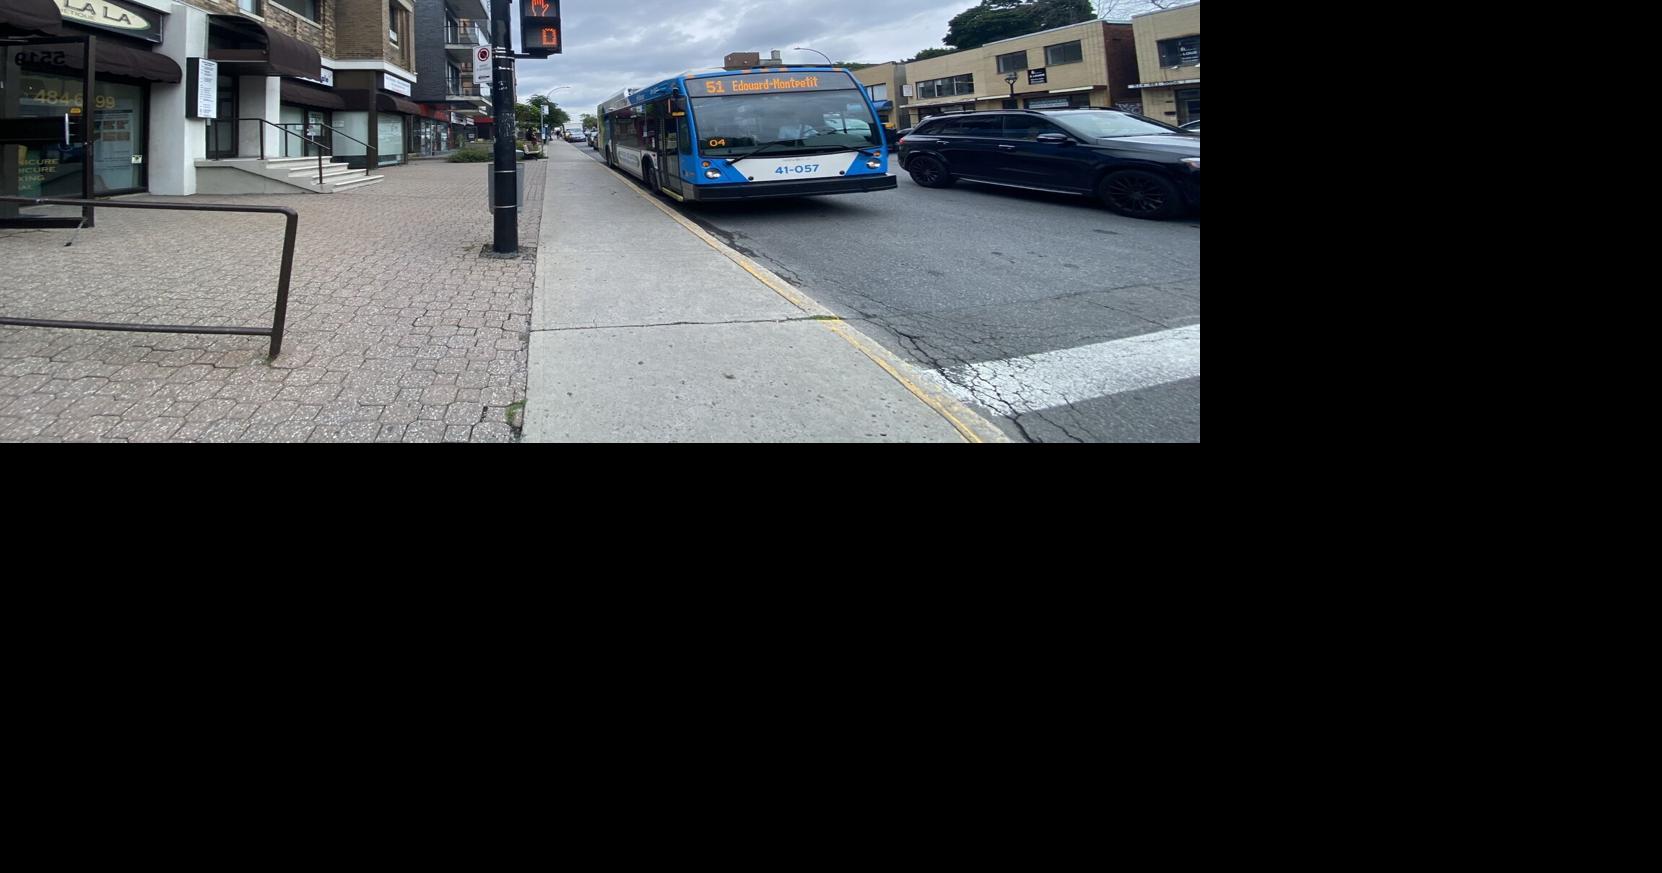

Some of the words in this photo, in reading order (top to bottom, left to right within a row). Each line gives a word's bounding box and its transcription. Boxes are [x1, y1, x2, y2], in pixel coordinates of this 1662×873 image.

[103, 6, 132, 25] LA
[705, 81, 725, 93] 51
[709, 138, 726, 147] 04
[775, 163, 819, 175] 41-057
